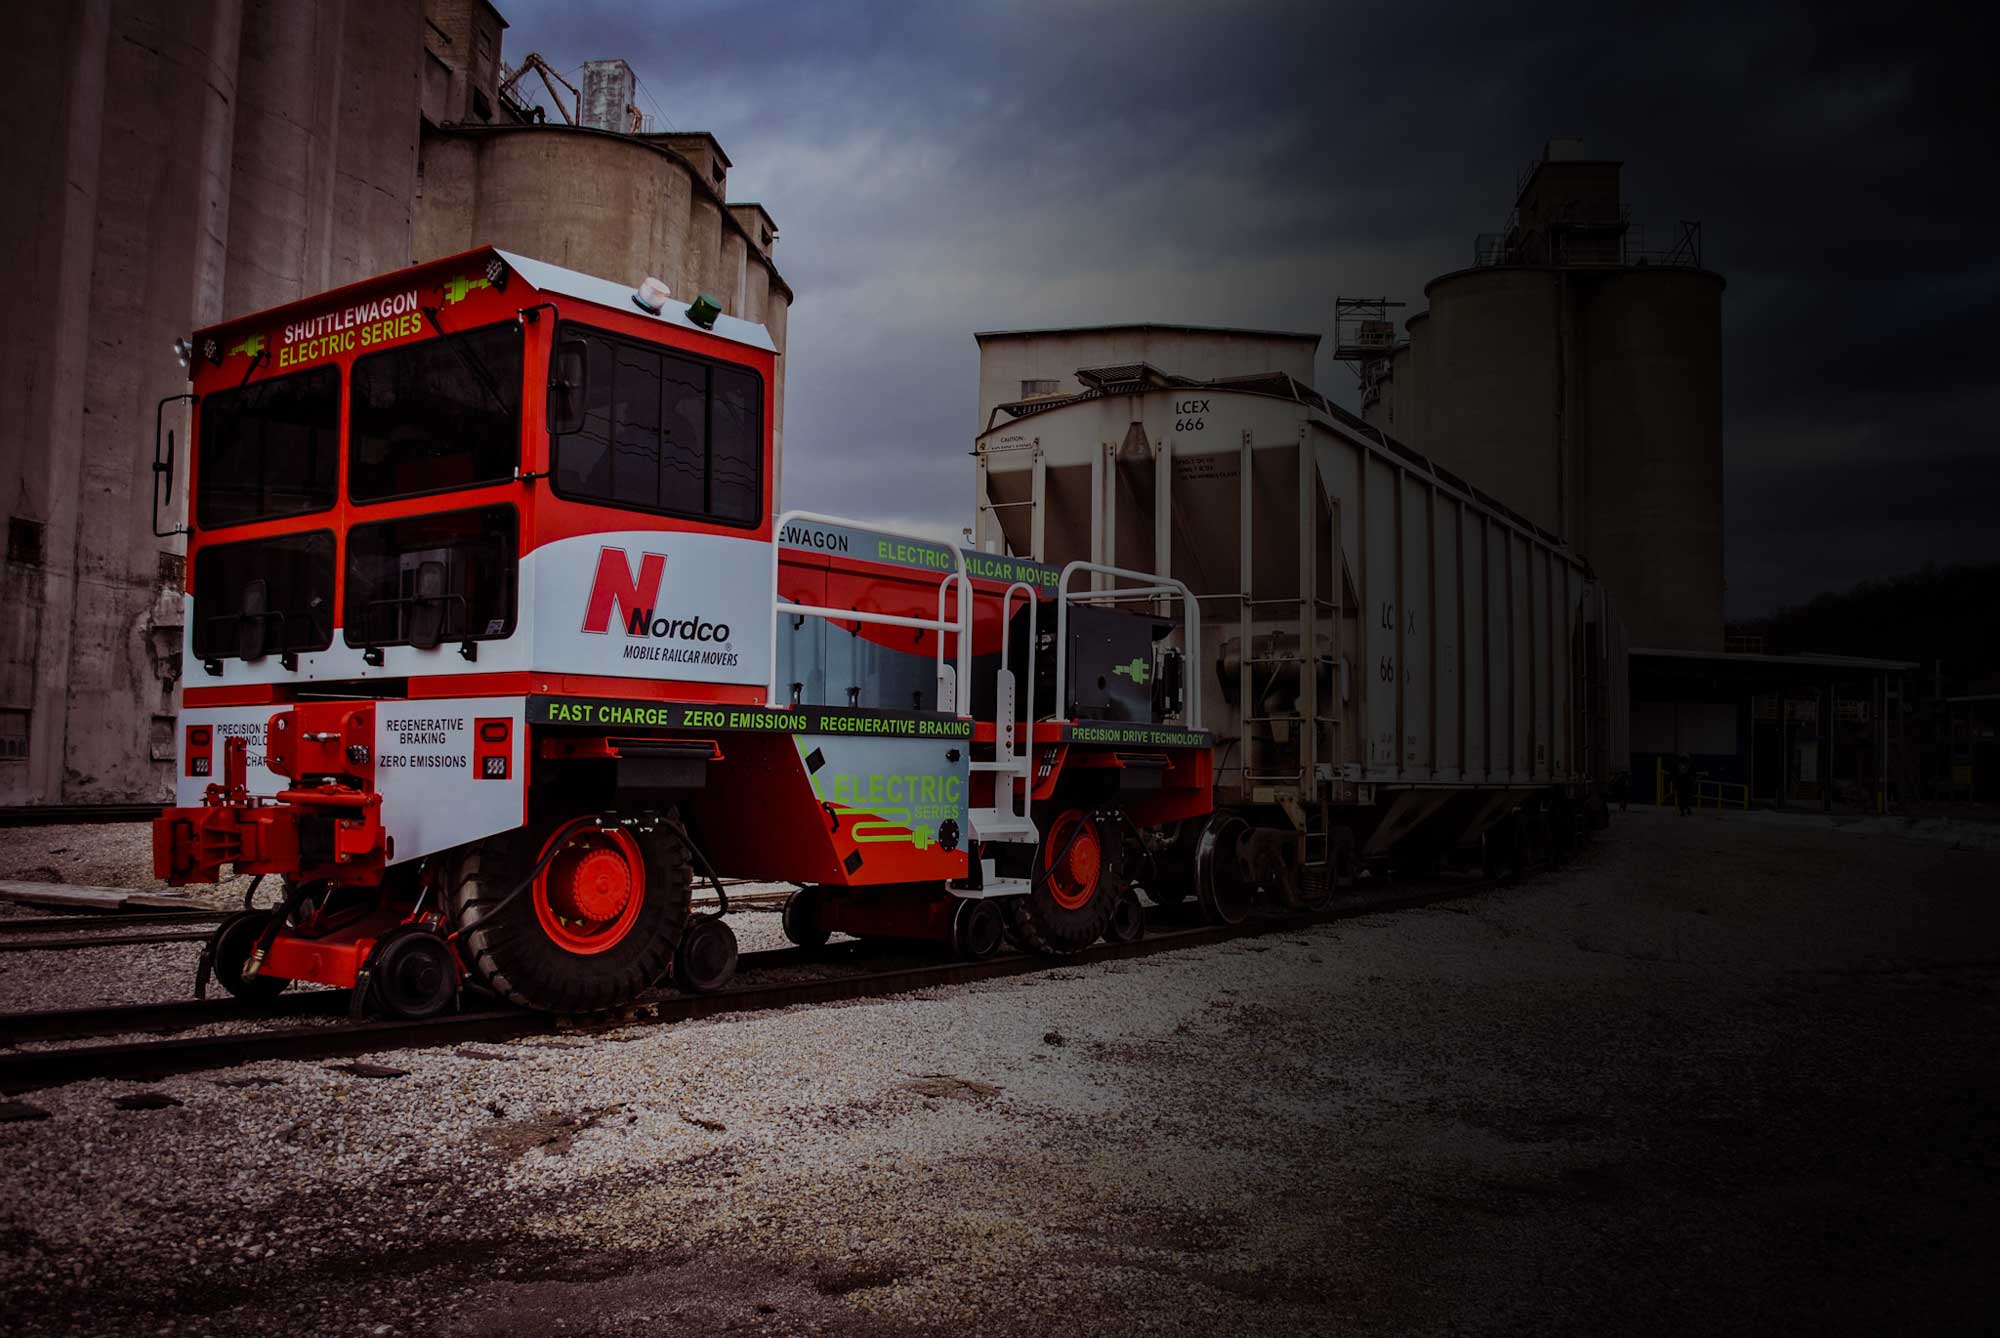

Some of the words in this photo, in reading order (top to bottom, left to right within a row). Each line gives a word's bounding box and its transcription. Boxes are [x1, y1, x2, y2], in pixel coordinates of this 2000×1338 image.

[283, 289, 417, 344] SHUTTLEWAGON
[279, 330, 355, 367] ELECTRIC
[361, 312, 421, 346] SERIES
[1176, 400, 1210, 414] LCEX
[1175, 419, 1204, 431] 666
[878, 541, 949, 569] ELECTRIC
[582, 546, 667, 638] N
[628, 607, 729, 642] Nordco
[1382, 602, 1415, 635] LCX
[623, 645, 660, 661] MOBILE
[661, 648, 700, 664] RAILCAR
[701, 651, 738, 667] MOVERS
[1380, 656, 1409, 684] 66
[217, 724, 261, 734] PRECISION
[386, 719, 464, 731] REGENERATIVE
[549, 703, 593, 721] FAST
[598, 706, 668, 725] CHARGE
[683, 710, 725, 727] ZERO
[729, 712, 808, 729] EMISSIONS
[820, 716, 915, 734] REGENERATIVE
[919, 720, 970, 735] BRAKING
[400, 732, 446, 744] BRAKING
[1072, 727, 1121, 742] PRECISION
[1122, 731, 1148, 743] DRIVE
[1151, 732, 1204, 745] TECHNOLOGY
[380, 755, 407, 767] ZERO
[410, 755, 467, 767] EMISSIONS
[834, 775, 961, 802] ELECTRIC
[914, 806, 960, 819] SERIES
